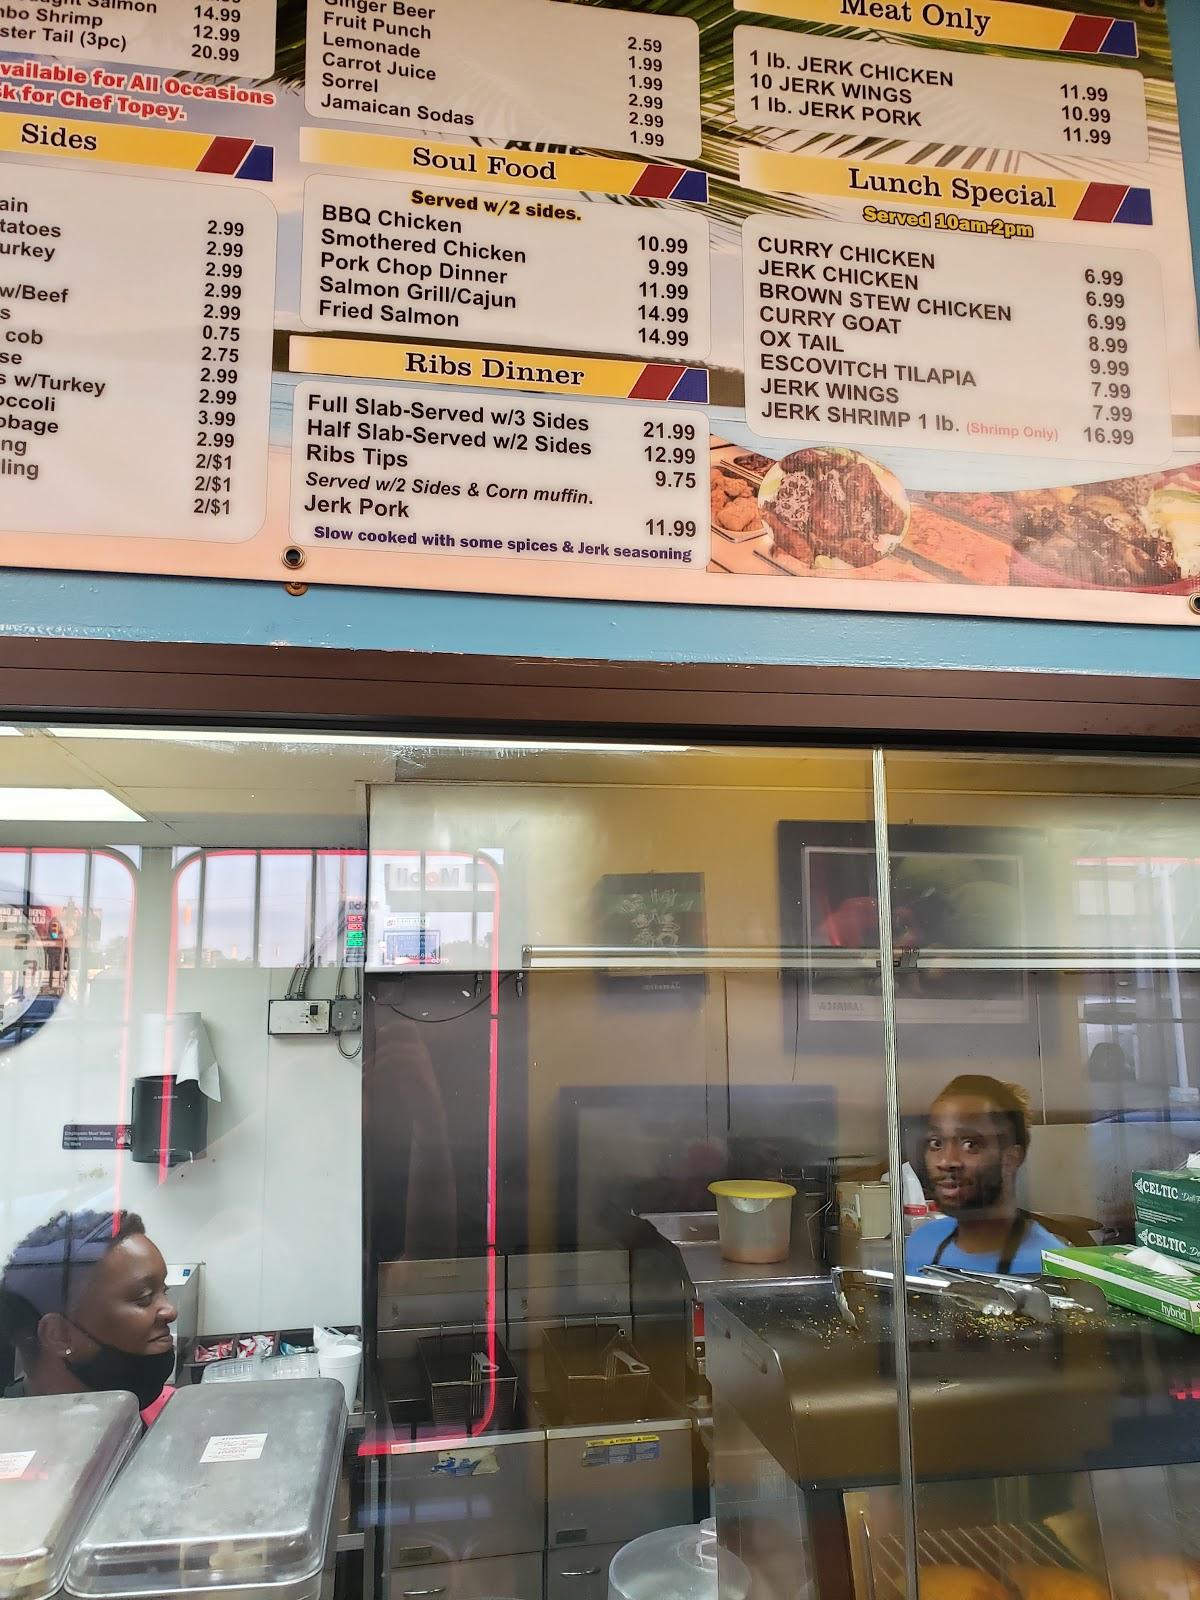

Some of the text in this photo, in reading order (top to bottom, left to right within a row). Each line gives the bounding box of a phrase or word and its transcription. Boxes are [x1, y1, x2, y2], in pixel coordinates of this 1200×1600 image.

[36, 9, 102, 29] Shrimp
[393, 1, 435, 19] Beer
[840, 0, 991, 36] Meat Only
[194, 25, 240, 42] 12.99
[324, 11, 430, 39] Fruit Punch
[0, 26, 126, 52] ster Tail (3pc)
[323, 32, 420, 58] Lemonade
[628, 37, 662, 52] 2.59
[192, 44, 239, 61] 20.99
[323, 52, 436, 80] Carrot Juice
[750, 50, 953, 86] 1 lb. JERK CHICKEN
[0, 62, 274, 105] vailable for All Occasions
[322, 73, 377, 92] Sorrel
[629, 75, 662, 91] 1.99
[751, 73, 911, 104] 10 JERK WINGS
[22, 86, 185, 120] for Chef Topey.
[321, 94, 474, 125] Jamaican Sodas
[751, 95, 921, 126] 1 lb. JERK PORK
[1062, 105, 1110, 123] 10.99
[22, 123, 96, 150] Sides
[630, 131, 664, 146] 1.99
[1064, 127, 1111, 144] 11.99
[414, 147, 556, 179] Soul Food
[849, 168, 1056, 207] Lunch Special
[411, 190, 581, 220] Served w/2 sides.
[0, 219, 61, 237] tatoes
[323, 204, 461, 233] BBQ Chicken
[863, 206, 1034, 238] Served 10am-2pm
[0, 242, 55, 262] urkey
[206, 241, 243, 257] 2.99
[321, 228, 525, 263] Smothered Chicken
[638, 235, 687, 254] 10.99
[758, 237, 934, 269] CURRY CHICKEN
[322, 252, 507, 284] Pork Chop Dinner
[649, 259, 688, 277] 9.99
[759, 260, 918, 290] JERK CHICKEN
[0, 284, 68, 303] w/Beef
[320, 276, 515, 310] Salmon Grill/Cajun
[760, 282, 1011, 321] BROWN STEW CHICKEN
[204, 304, 240, 320] 2.99
[320, 300, 458, 327] Fried Salmon
[760, 306, 901, 334] CURRY GOAT
[1088, 314, 1126, 331] 6.99
[6, 330, 43, 344] cob
[203, 325, 239, 341] 0.75
[639, 328, 688, 346] 14.99
[760, 330, 844, 352] OX TAIL
[202, 346, 238, 362] 2.75
[1089, 336, 1127, 353] 8.99
[405, 353, 584, 385] Ribs Dinner
[761, 354, 976, 386] ESCOVITCH TILAPIA
[1090, 359, 1129, 376] 9.99
[14, 373, 105, 400] w/Turkey
[761, 378, 899, 403] JERK WINGS
[198, 410, 235, 426] 3.99
[309, 394, 588, 431] Full Slab-Served w/3 Sides
[762, 402, 1058, 442] JERK SHRIMP 1 lb. (Shrimp Only)
[1093, 405, 1132, 422] 7.99
[197, 432, 234, 448] 2.99
[308, 419, 591, 455] Half Slab-Served w/2 Sides
[644, 422, 695, 440] 21.99
[1084, 427, 1133, 445] 16.99
[2, 440, 26, 456] ng
[307, 444, 407, 470] Ribs Tips
[645, 446, 695, 464] 12.99
[2, 459, 38, 480] ling
[656, 471, 696, 488] 9.75
[306, 472, 592, 504] Served w/2 Sides & Corn muffin.
[194, 498, 229, 516] 2/$1
[305, 495, 409, 518] Jerk Pork
[314, 526, 692, 563] Slow cooked with some spices & Jerk seasoning
[1143, 1181, 1178, 1200] CELTIC
[1148, 1232, 1186, 1254] CELTIC
[1161, 1302, 1187, 1321] hybrid
